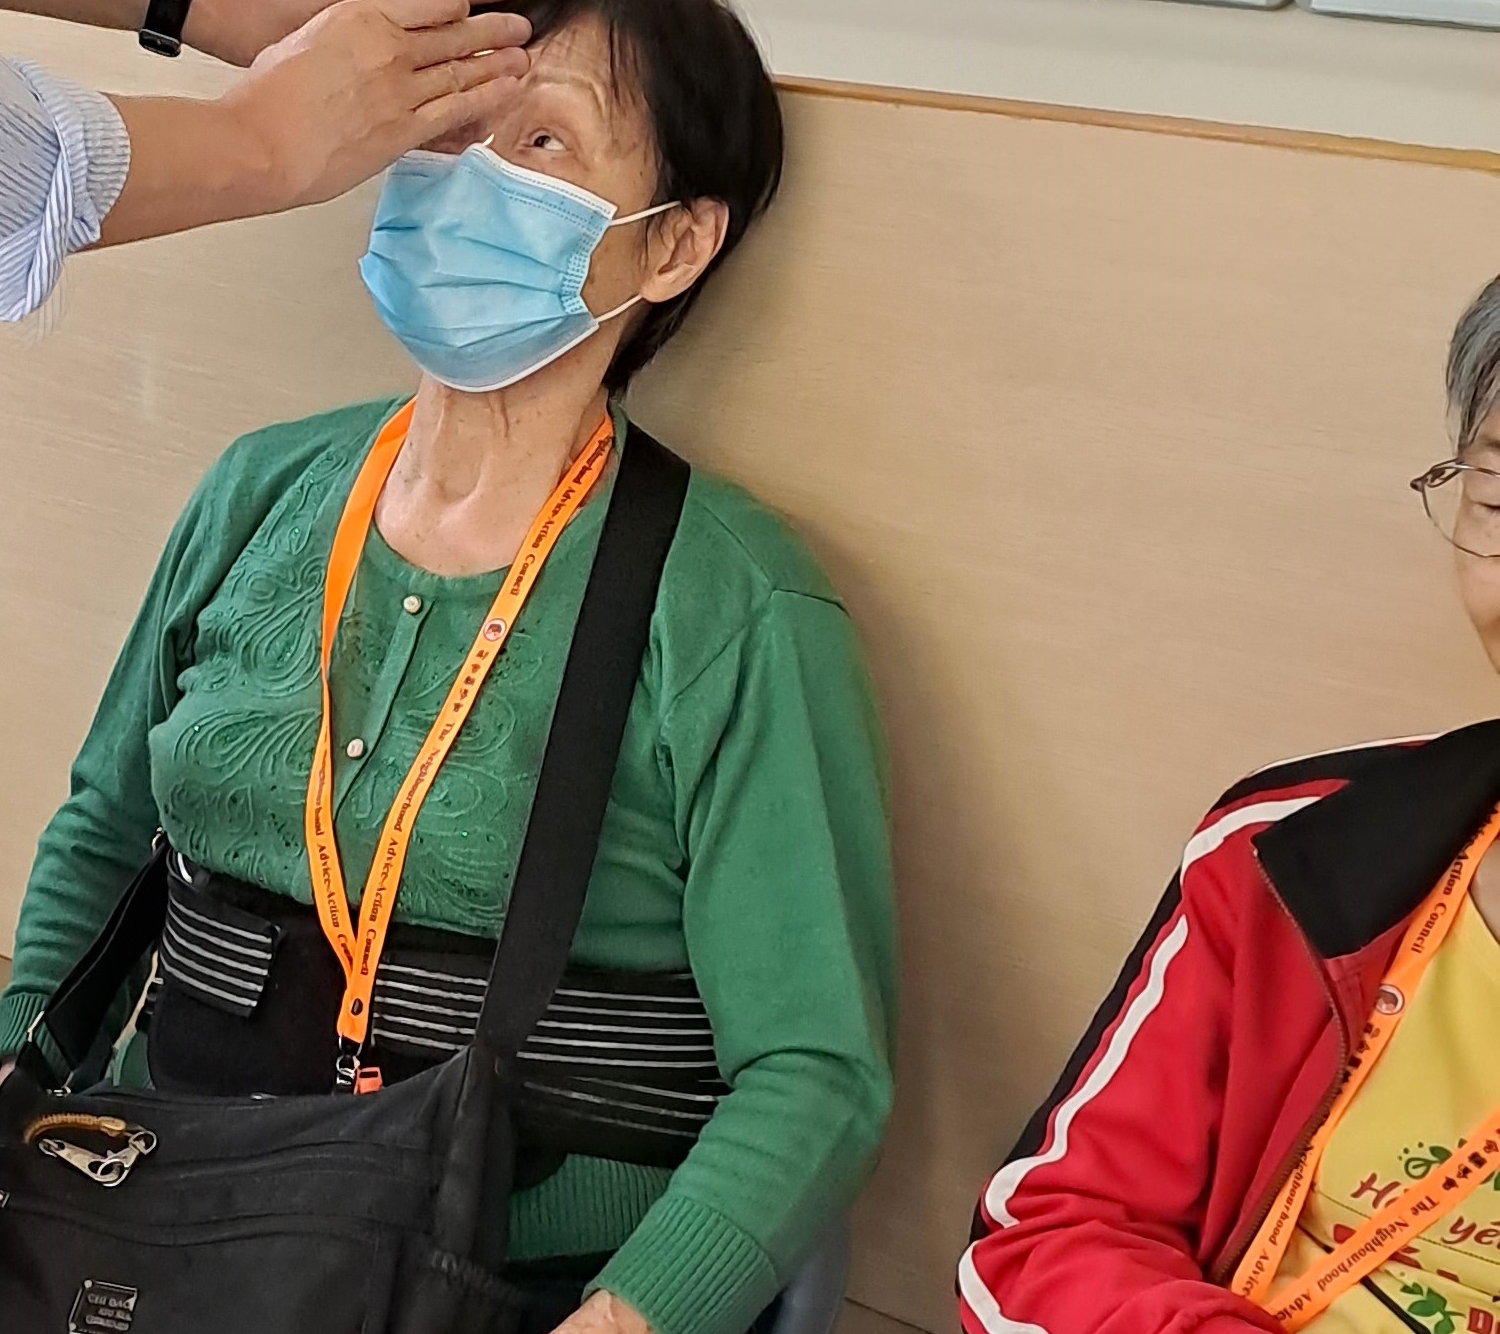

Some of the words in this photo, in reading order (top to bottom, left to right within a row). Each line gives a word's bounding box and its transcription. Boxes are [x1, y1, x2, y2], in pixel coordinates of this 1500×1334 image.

[1410, 902, 1447, 954] Council
[1410, 1195, 1440, 1216] The
[1317, 1217, 1409, 1292] Neighbourhood
